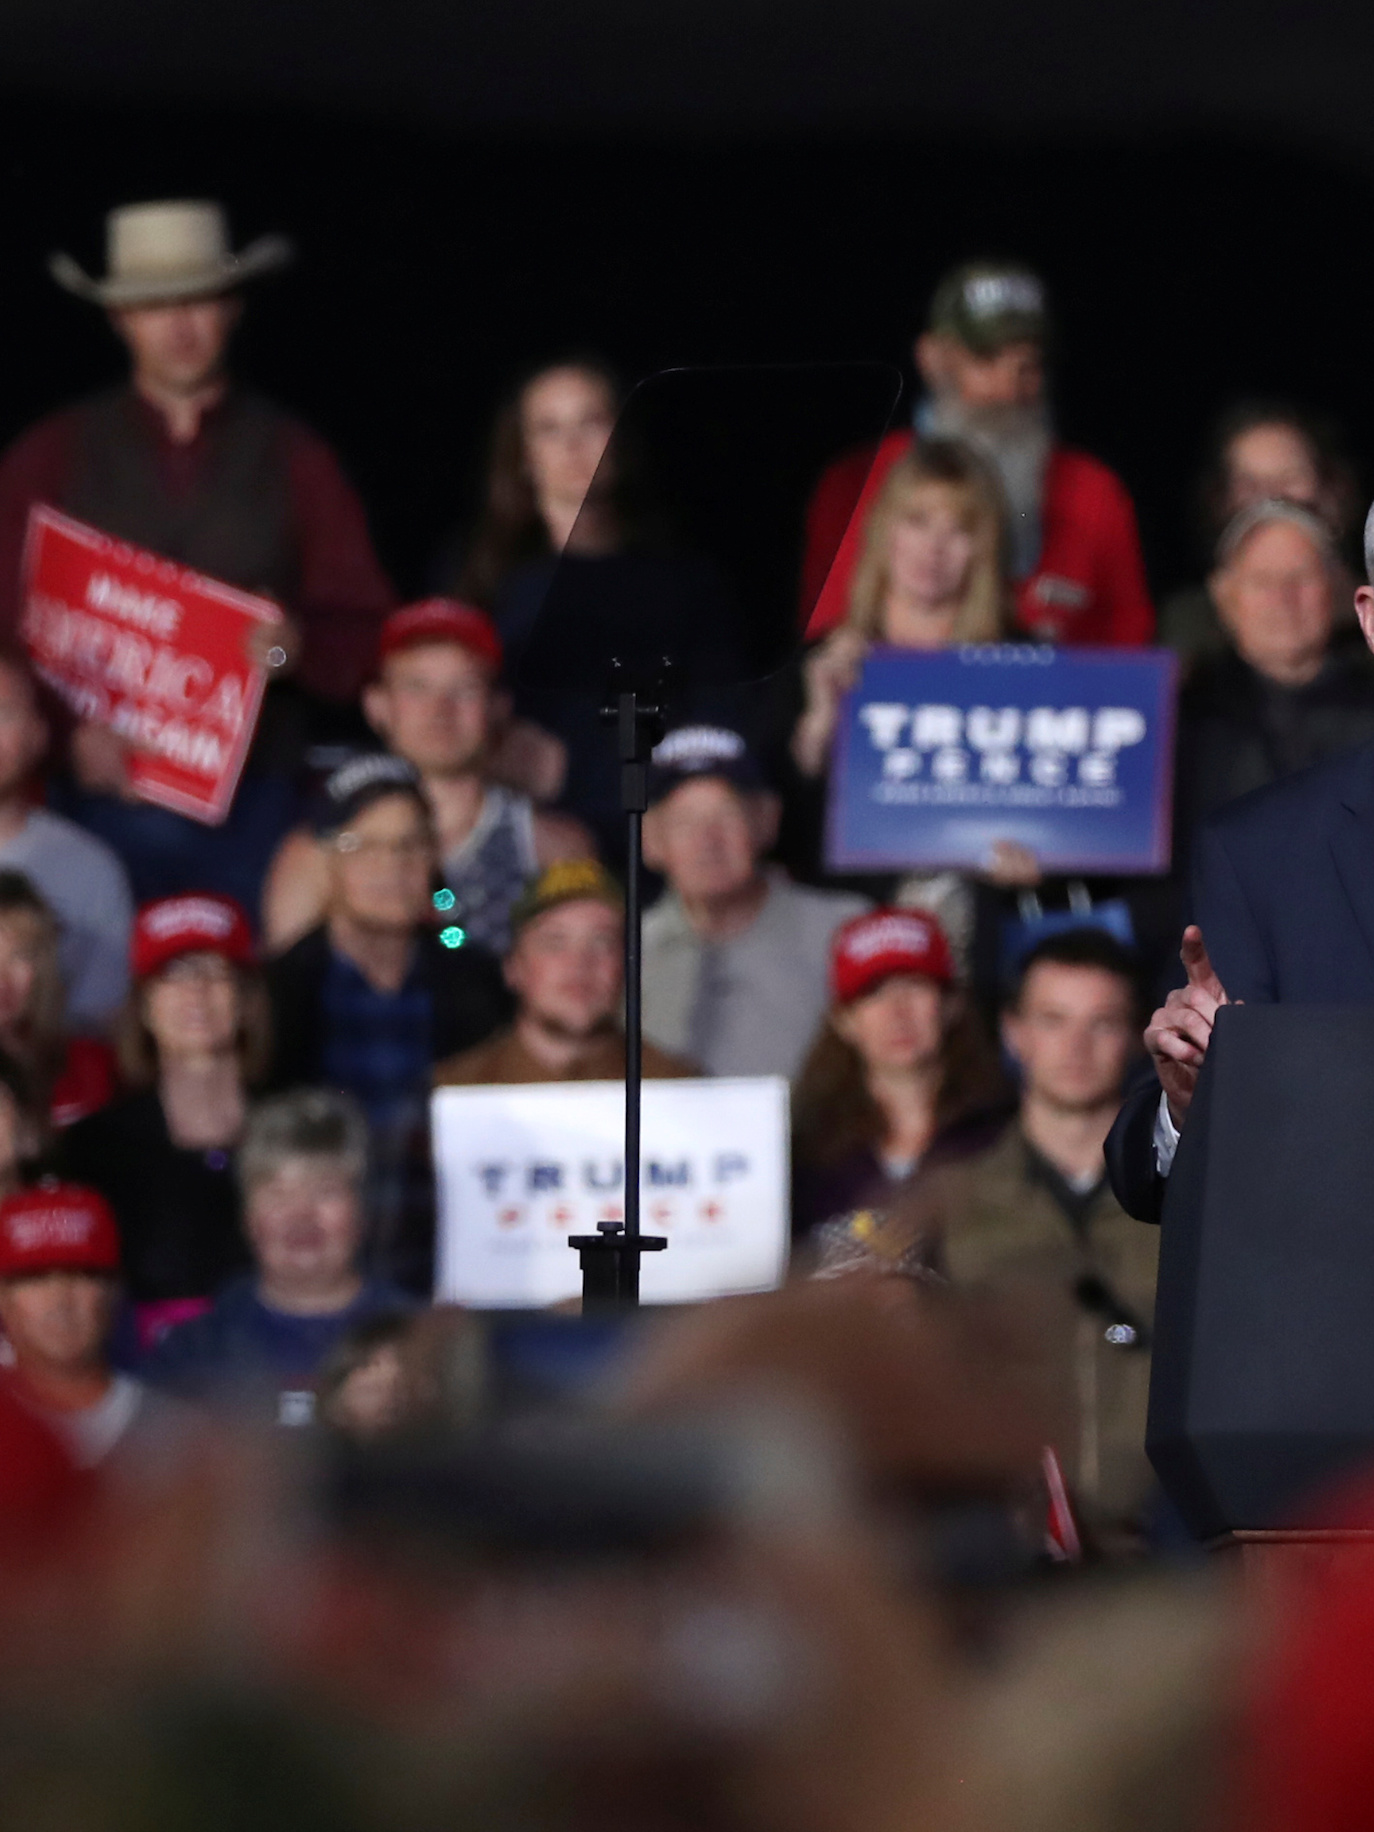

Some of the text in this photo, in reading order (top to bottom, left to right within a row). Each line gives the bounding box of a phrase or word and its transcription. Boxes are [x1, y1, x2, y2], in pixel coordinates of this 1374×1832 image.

[860, 702, 1147, 751] TRUMP
[883, 749, 1117, 788] PENCE
[480, 1152, 749, 1195] TRUMP
